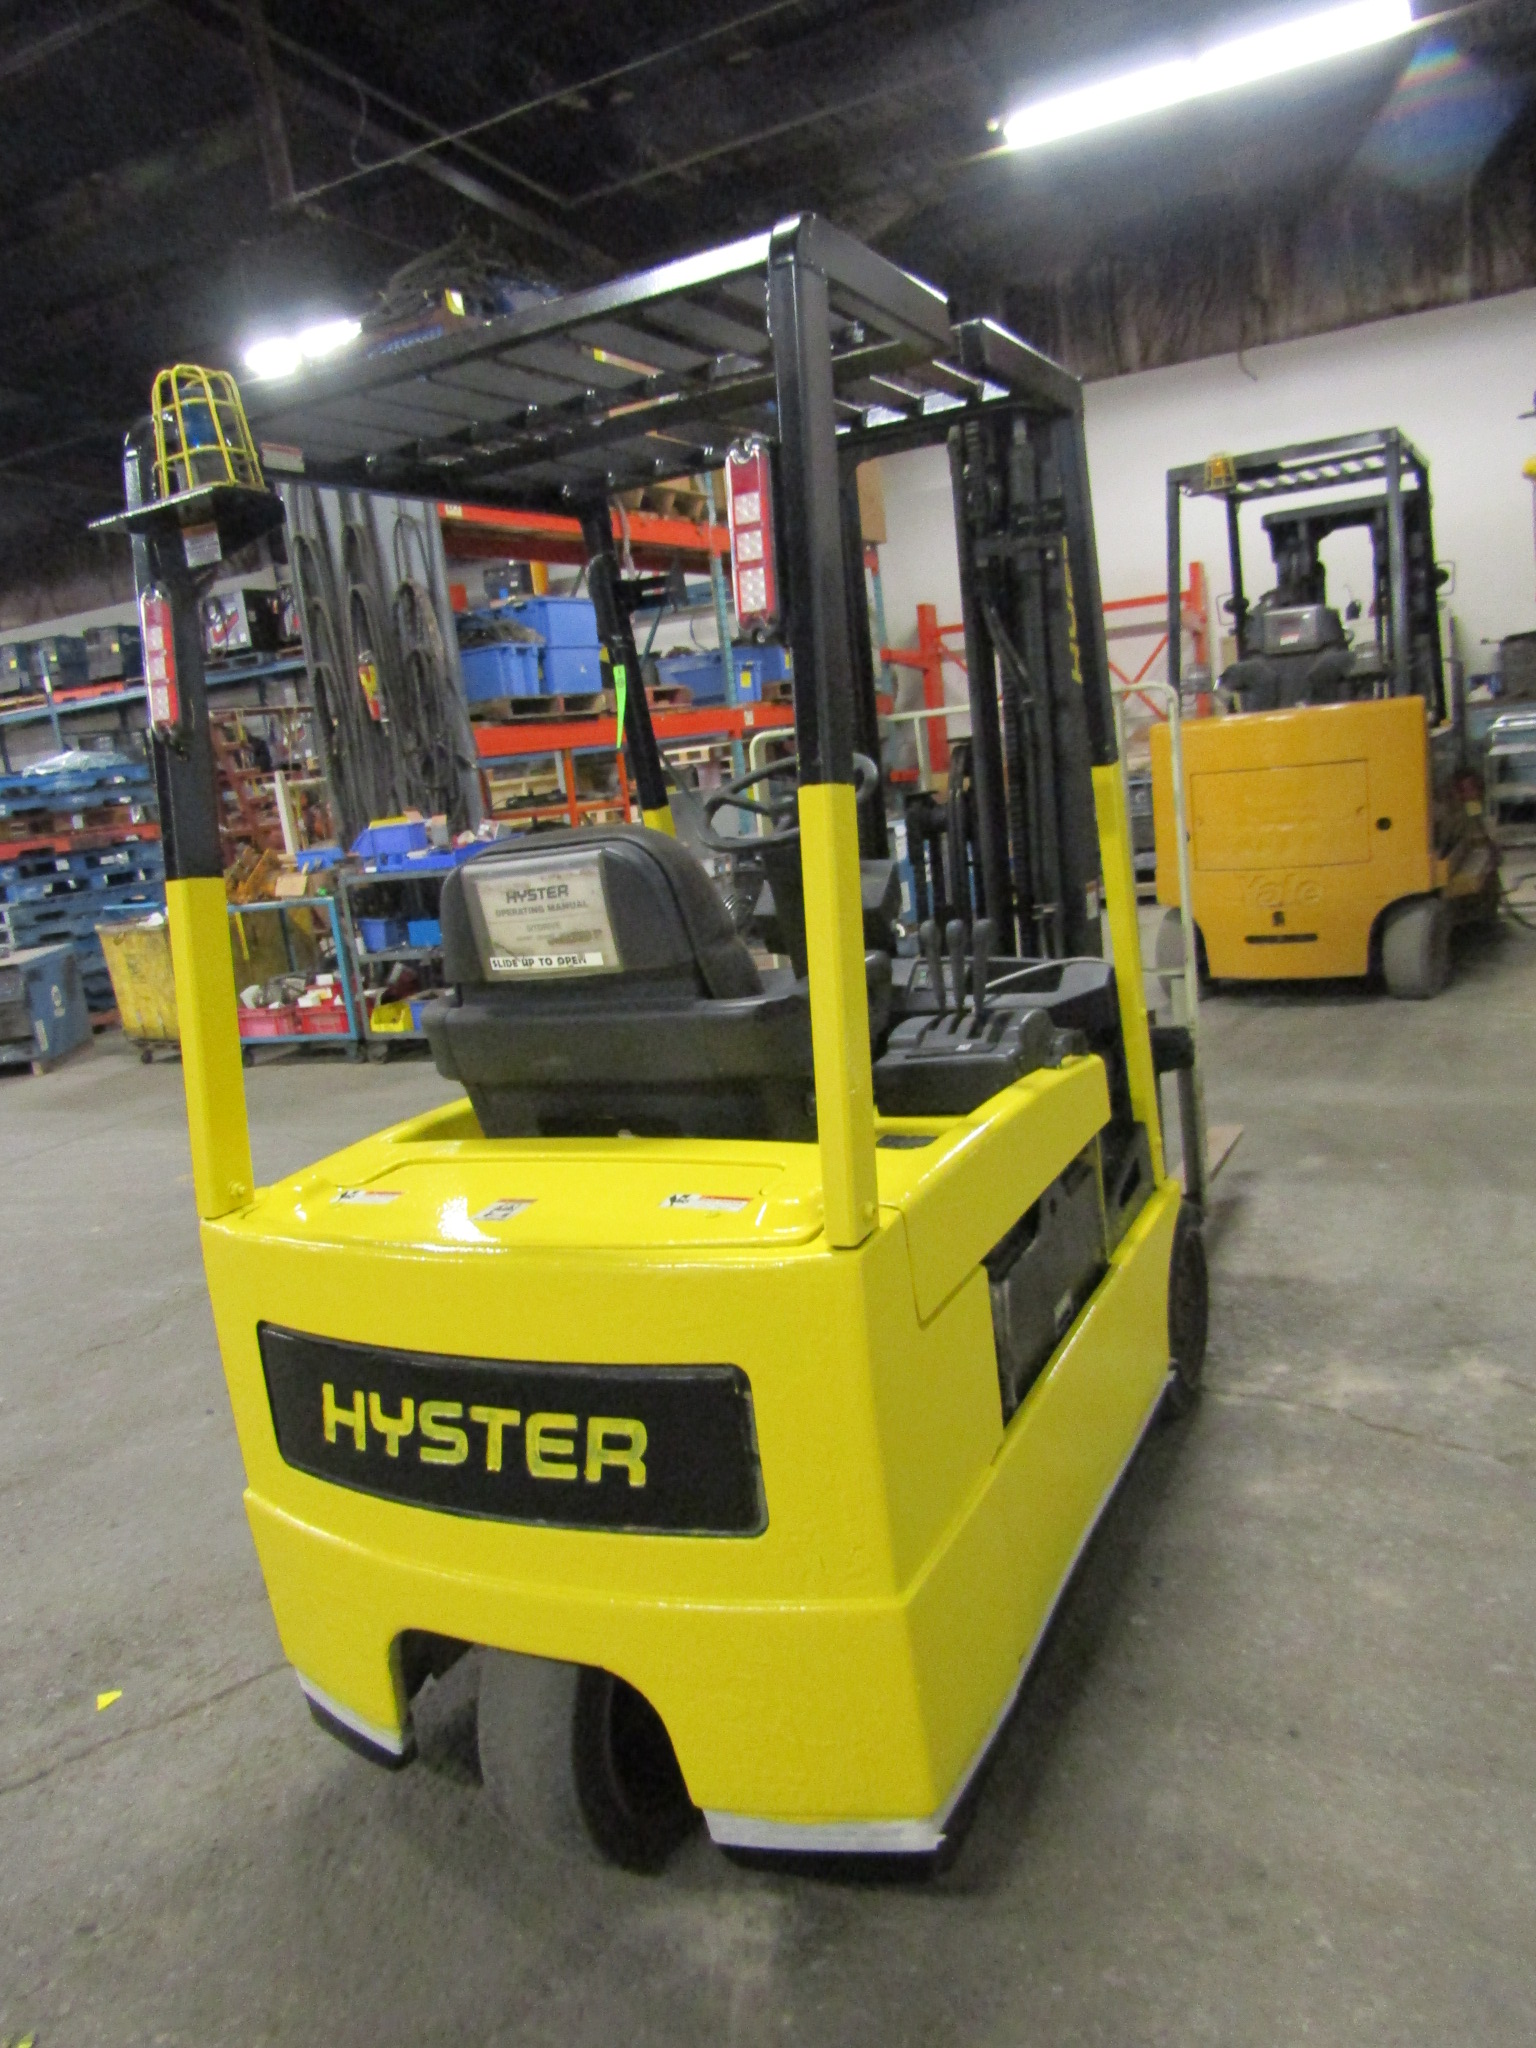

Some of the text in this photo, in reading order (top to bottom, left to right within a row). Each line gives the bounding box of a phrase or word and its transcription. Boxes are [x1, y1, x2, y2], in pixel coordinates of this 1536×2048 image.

[506, 884, 568, 903] HYSTER
[1239, 873, 1321, 907] Yale
[496, 900, 587, 917] OPERATING MANUAL
[492, 955, 587, 969] SLIDE UP TO OPEN
[322, 1382, 648, 1488] HYSTER
